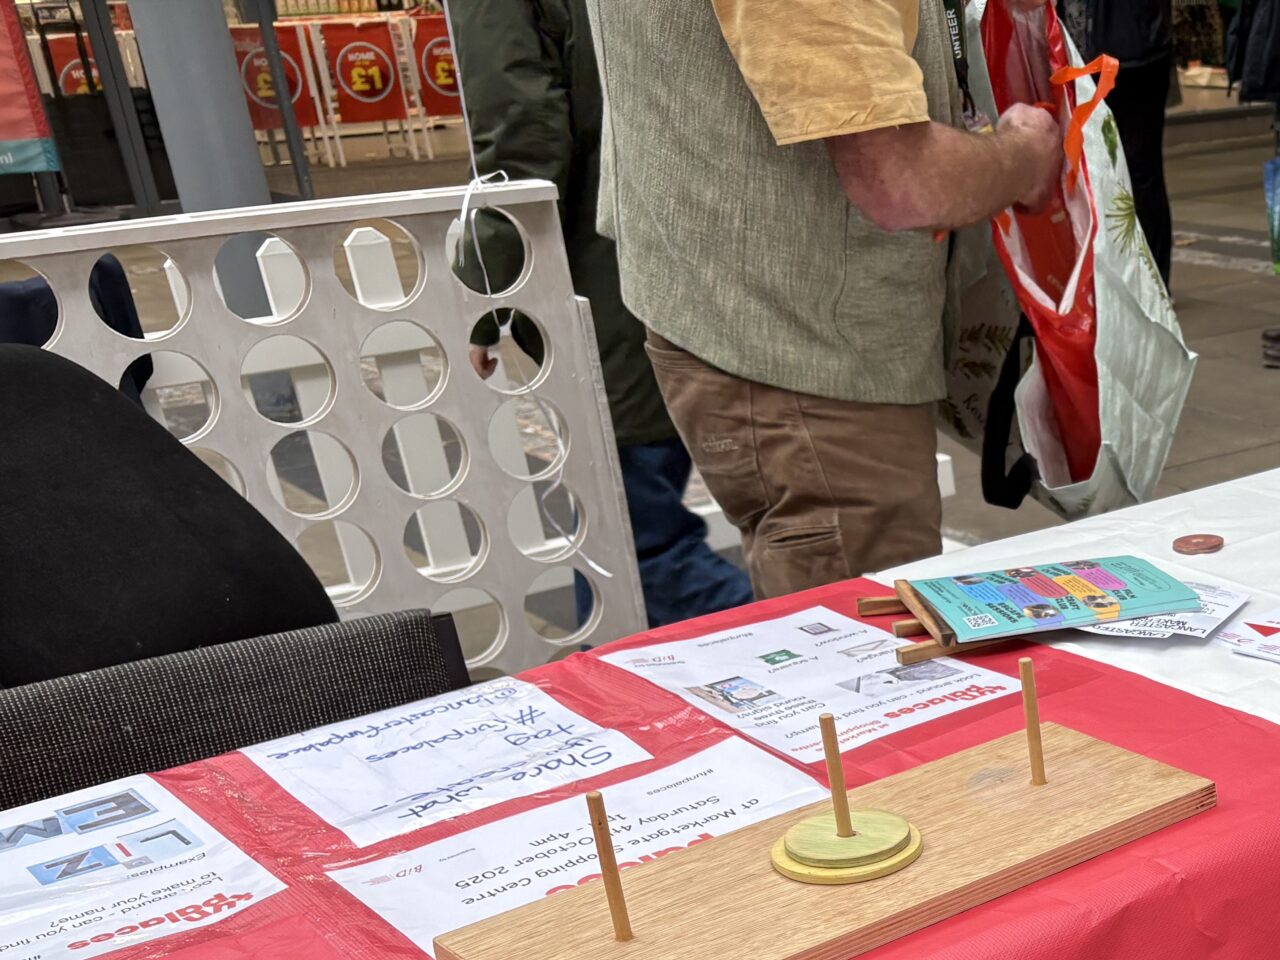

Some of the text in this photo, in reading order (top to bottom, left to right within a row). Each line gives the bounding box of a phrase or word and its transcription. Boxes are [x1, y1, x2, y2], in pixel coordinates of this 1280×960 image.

[347, 52, 376, 61] HOME
[351, 65, 383, 91] £1
[888, 694, 907, 703] can
[916, 679, 953, 696] around
[802, 703, 826, 713] Can
[843, 707, 866, 720] find
[864, 698, 887, 711] you
[883, 685, 981, 720] palaces
[778, 710, 802, 721] you
[504, 724, 575, 747] tag
[397, 745, 612, 819] Share what
[638, 795, 720, 826] Saturday
[741, 797, 760, 811] at
[628, 808, 737, 847] Marketgate
[529, 829, 571, 850] 4pm
[515, 837, 595, 868] October
[535, 844, 624, 879] Sopping
[124, 852, 206, 881] Examples:
[455, 866, 509, 889] 2025
[50, 871, 218, 928] to make your name?
[121, 891, 179, 915] around
[461, 877, 532, 906] Centre
[66, 892, 230, 951] palaces
[72, 916, 103, 929] can
[35, 926, 71, 941] you
